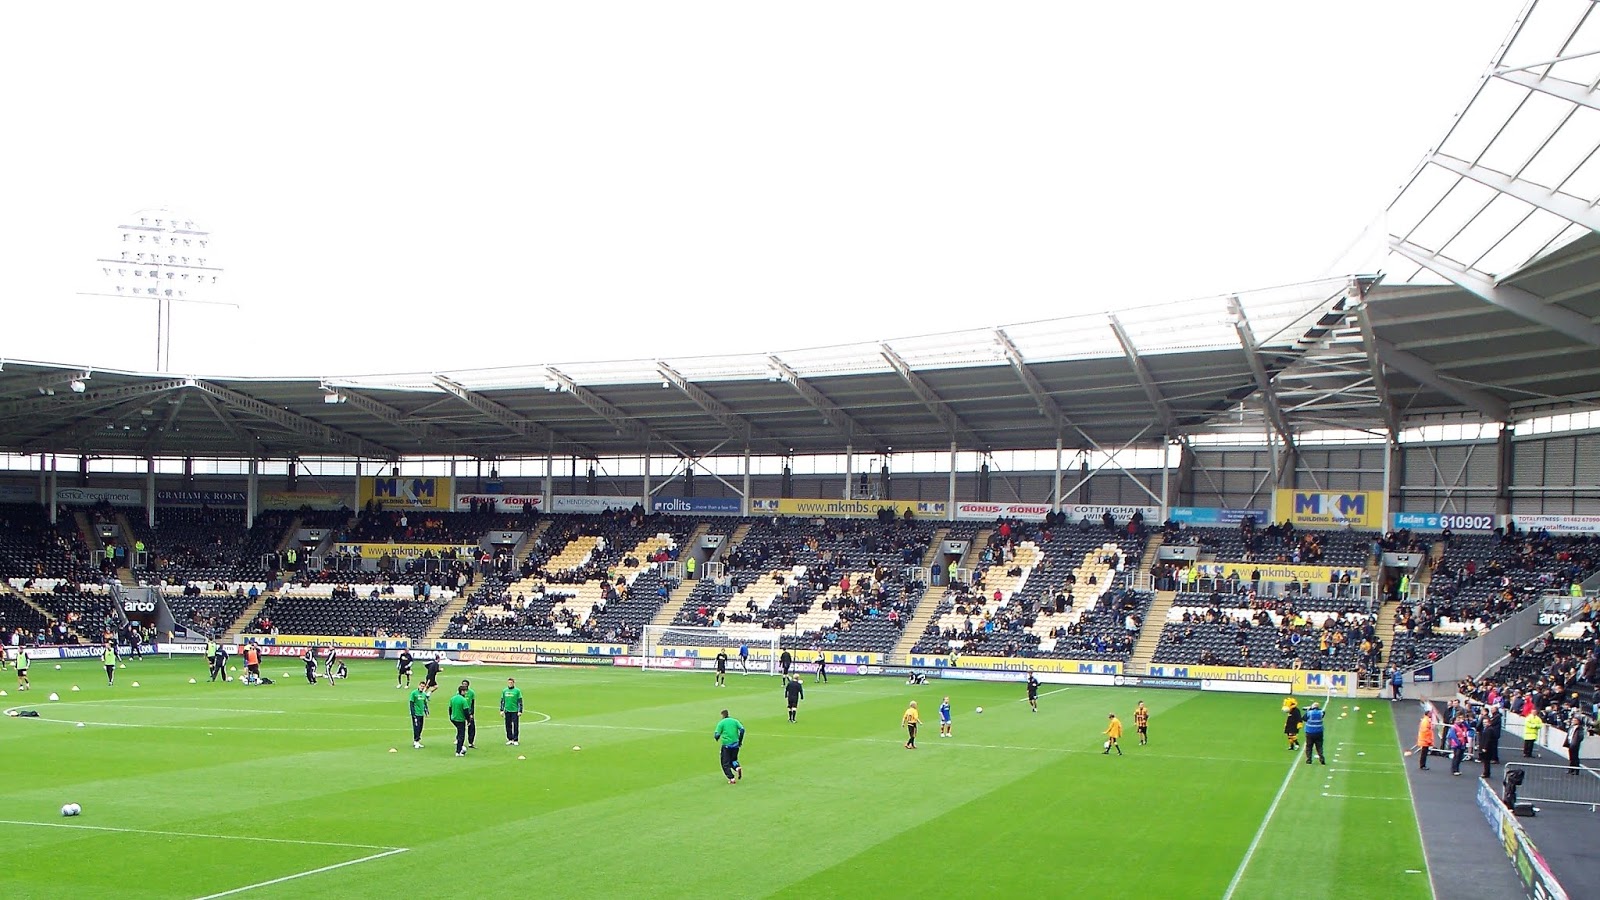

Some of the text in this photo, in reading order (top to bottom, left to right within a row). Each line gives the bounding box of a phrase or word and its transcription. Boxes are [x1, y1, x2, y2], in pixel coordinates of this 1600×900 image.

[158, 491, 246, 500] GRAHAM & ROSEN
[375, 478, 434, 506] MKM
[461, 496, 496, 504] BNUS
[504, 496, 540, 506] BONUS
[663, 498, 691, 511] rollits
[753, 500, 779, 511] MKM
[797, 500, 899, 514] www.mkmbs.cok
[918, 502, 945, 513] MKM
[961, 505, 1000, 513] BONUS
[1074, 506, 1144, 514] COTTINGHAM
[1296, 493, 1365, 522] MKM
[1398, 514, 1492, 530] Jadan 610902
[339, 546, 362, 555] MKM
[1198, 564, 1224, 574] MKM
[1236, 566, 1324, 580] wwwmkmbs.co.uk
[124, 602, 155, 612] arco
[1539, 613, 1567, 624] arco
[244, 635, 276, 646] MKM
[374, 640, 408, 650] MKM
[62, 648, 90, 658] Thomas
[324, 648, 352, 656] BAGAIN
[436, 642, 469, 650] MKM
[588, 646, 622, 656] MKM
[408, 650, 446, 660] TEXACO
[664, 648, 698, 658] MKM
[833, 654, 870, 664] MKM
[578, 657, 614, 666] totesport.com
[912, 656, 948, 667] MKM
[1079, 664, 1117, 674] MKM
[1150, 666, 1188, 678] MKM
[1306, 673, 1346, 687] MKM
